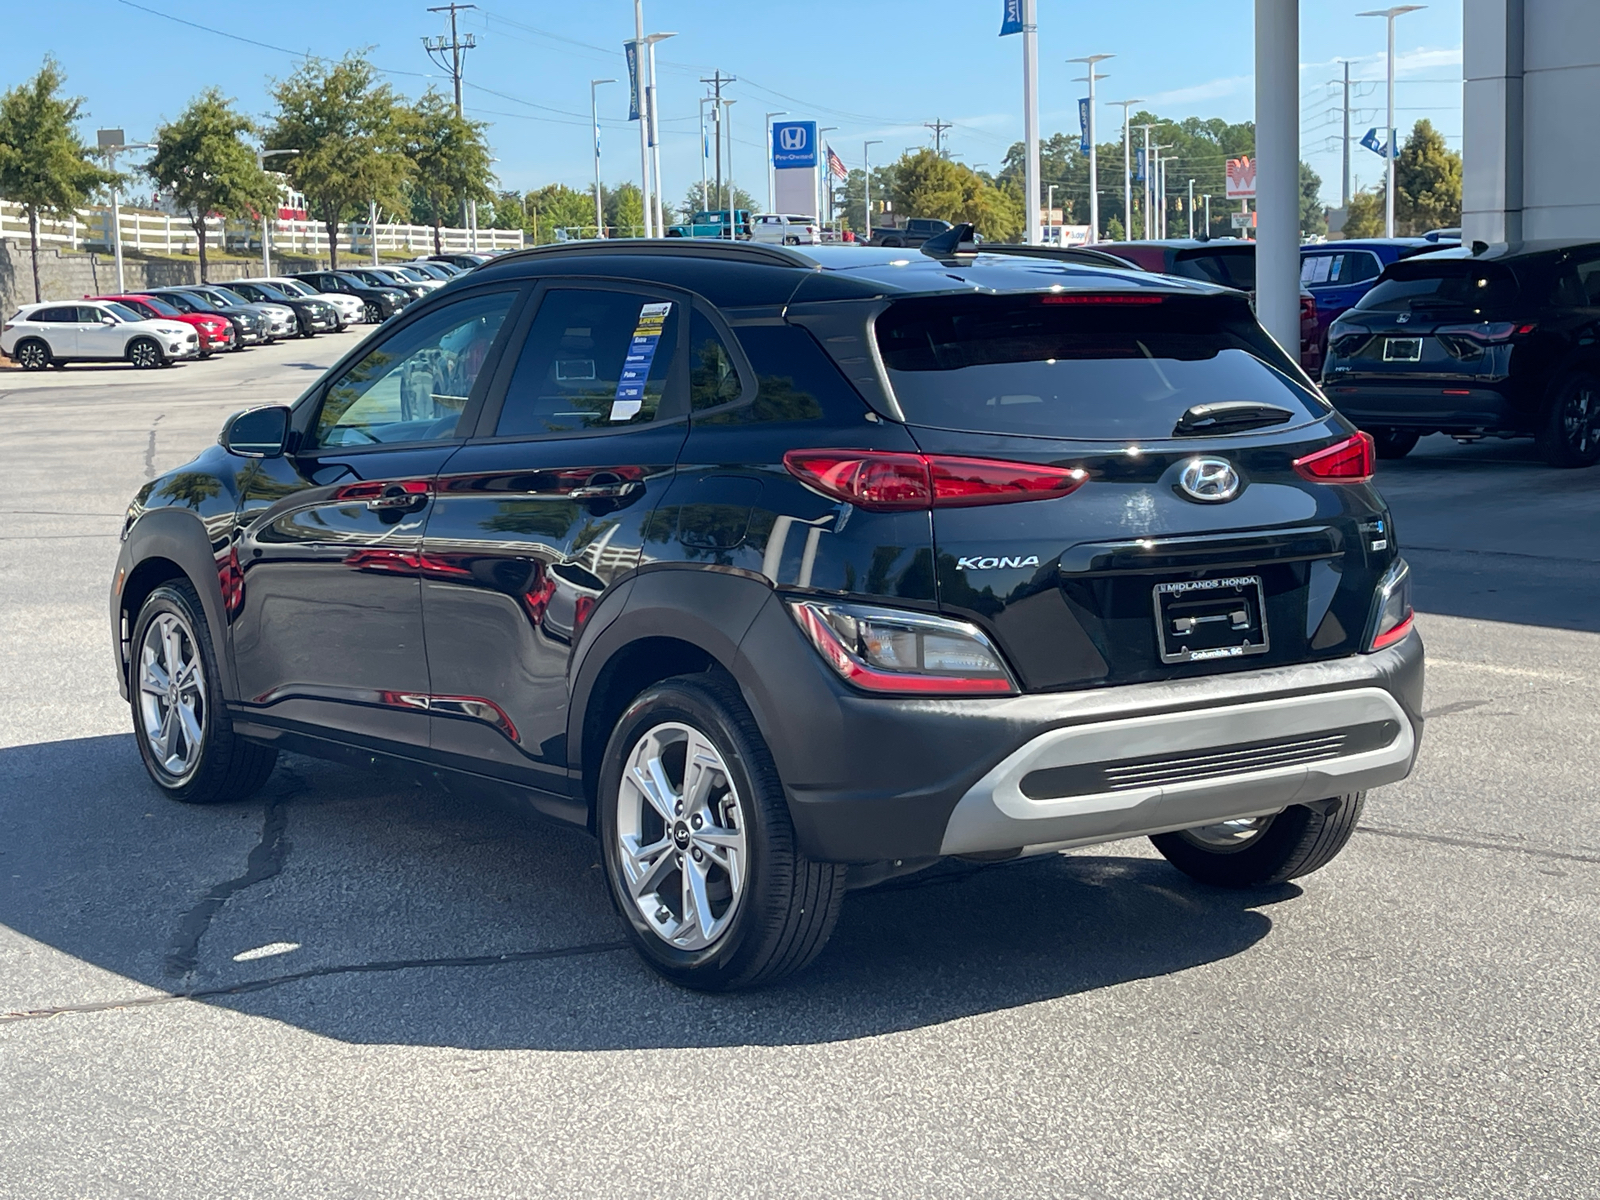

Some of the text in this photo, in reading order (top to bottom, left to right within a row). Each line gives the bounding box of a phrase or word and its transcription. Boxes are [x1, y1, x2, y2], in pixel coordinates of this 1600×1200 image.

[775, 153, 814, 161] Pre-Owned
[956, 555, 1039, 570] KONA
[1167, 577, 1256, 592] MIDLANDS HONDA
